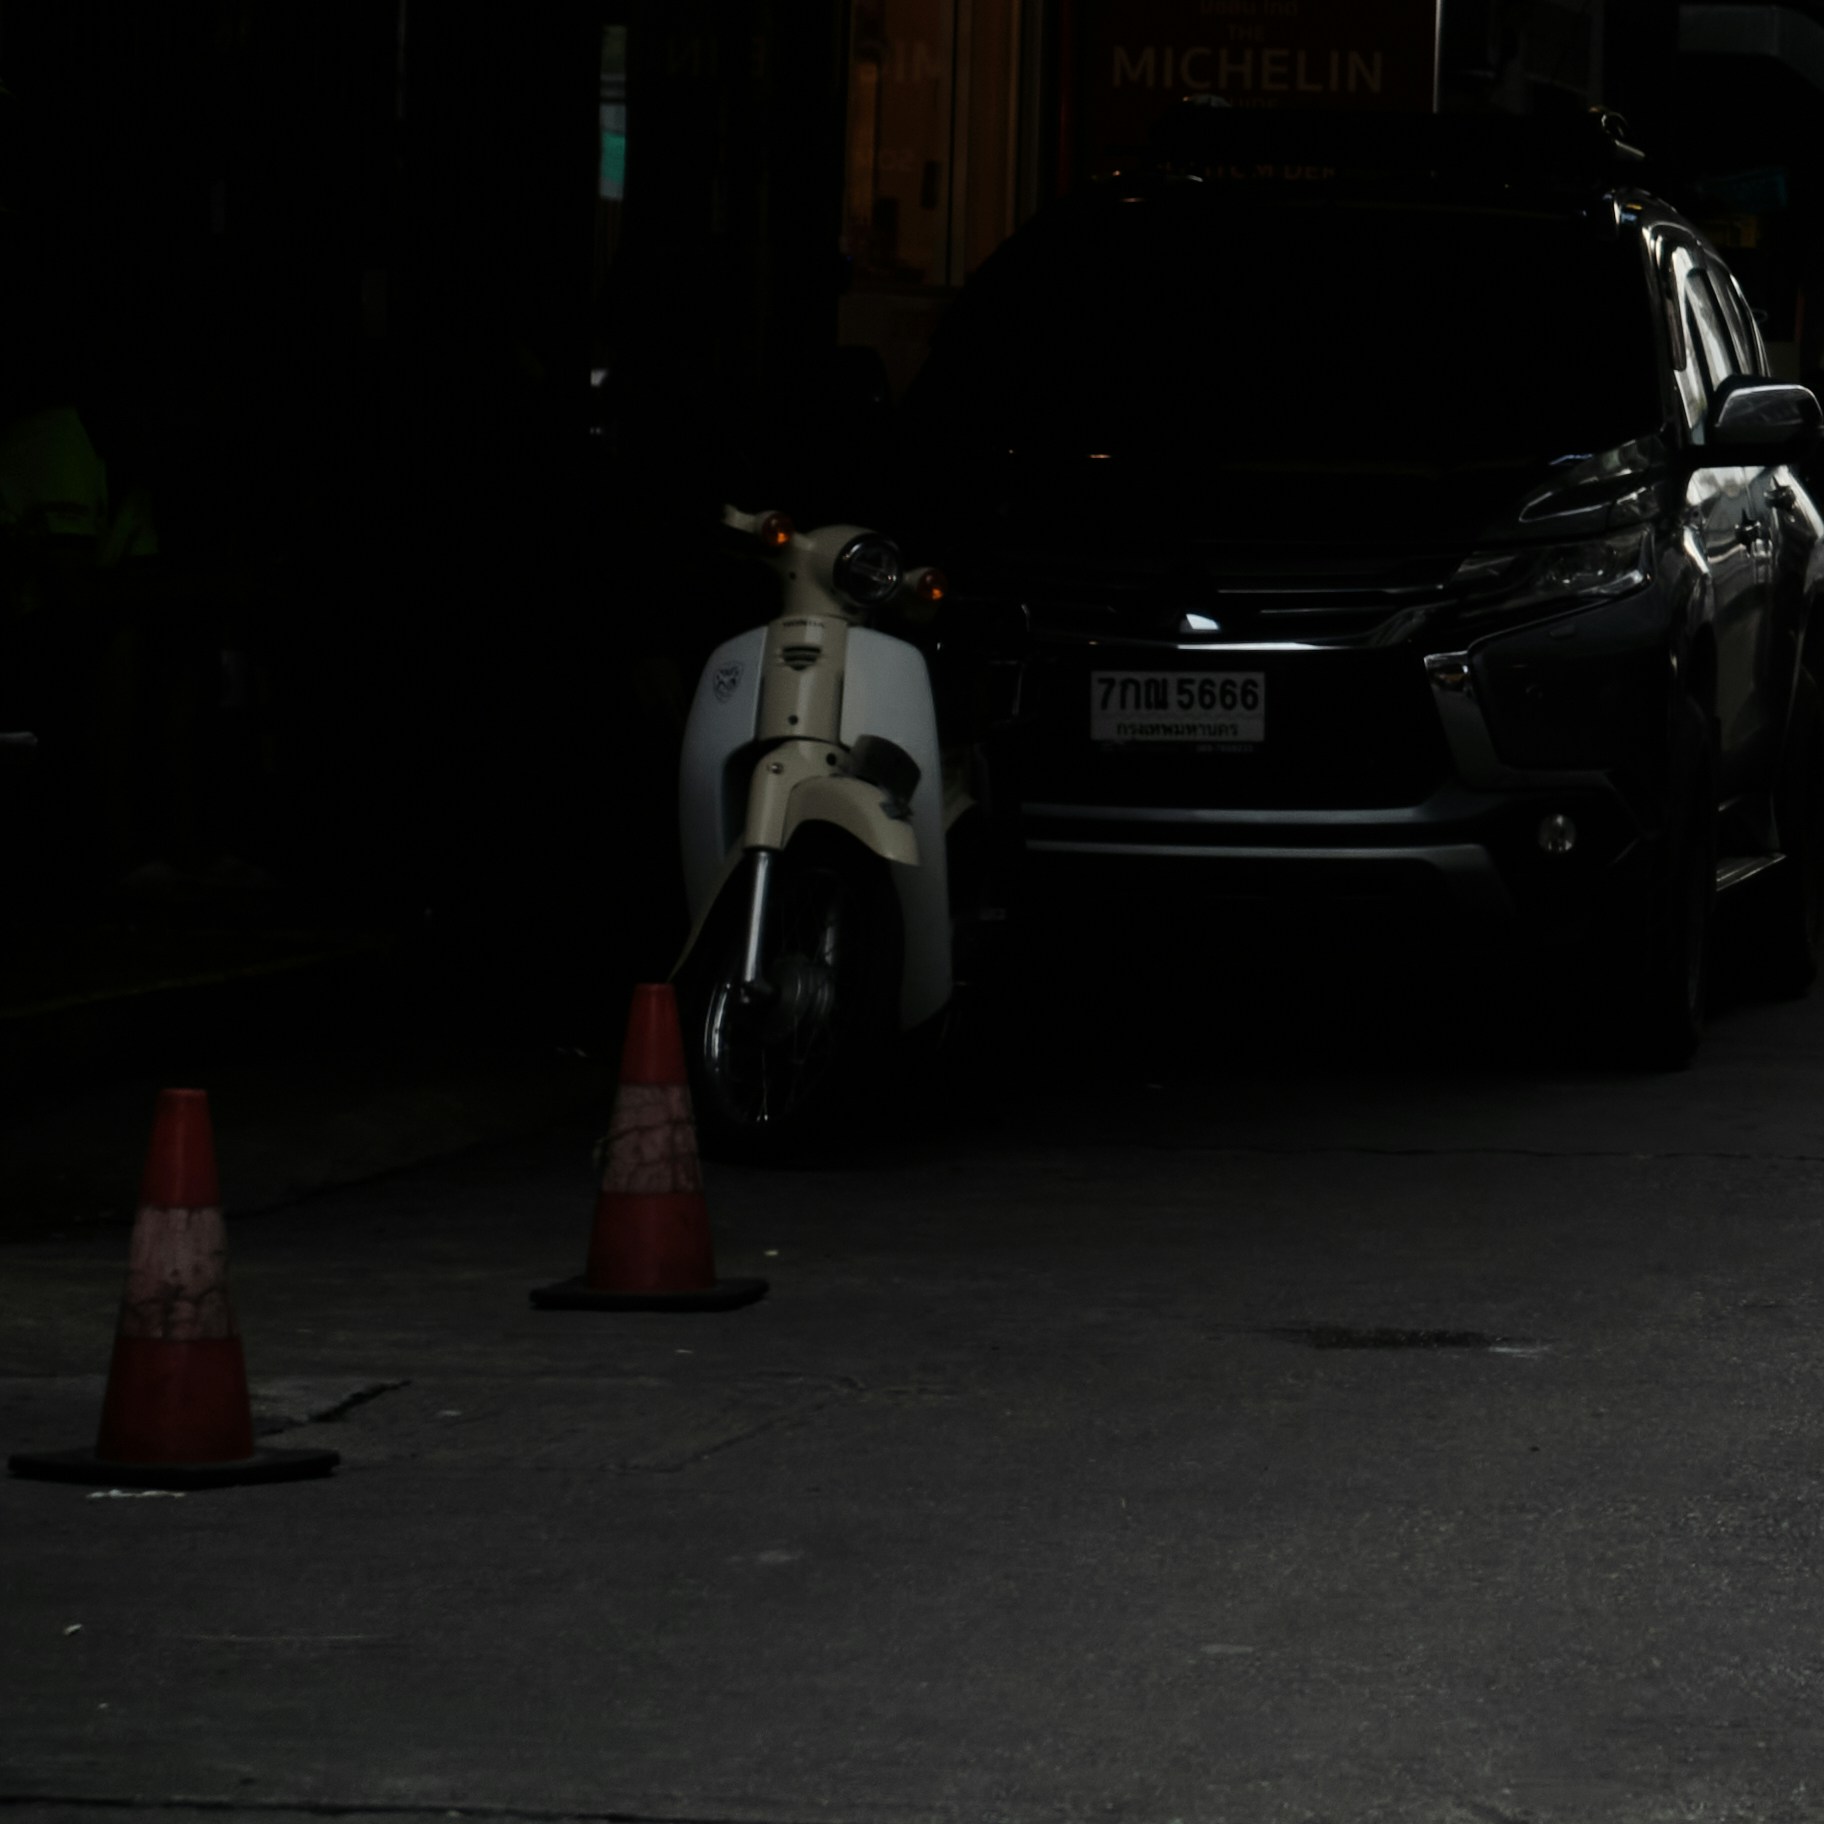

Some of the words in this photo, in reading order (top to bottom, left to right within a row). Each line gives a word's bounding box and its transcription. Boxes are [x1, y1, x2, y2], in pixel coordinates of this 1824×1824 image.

[1227, 24, 1265, 42] THE
[1112, 45, 1383, 94] MICHELIN
[1177, 677, 1259, 711] 5666
